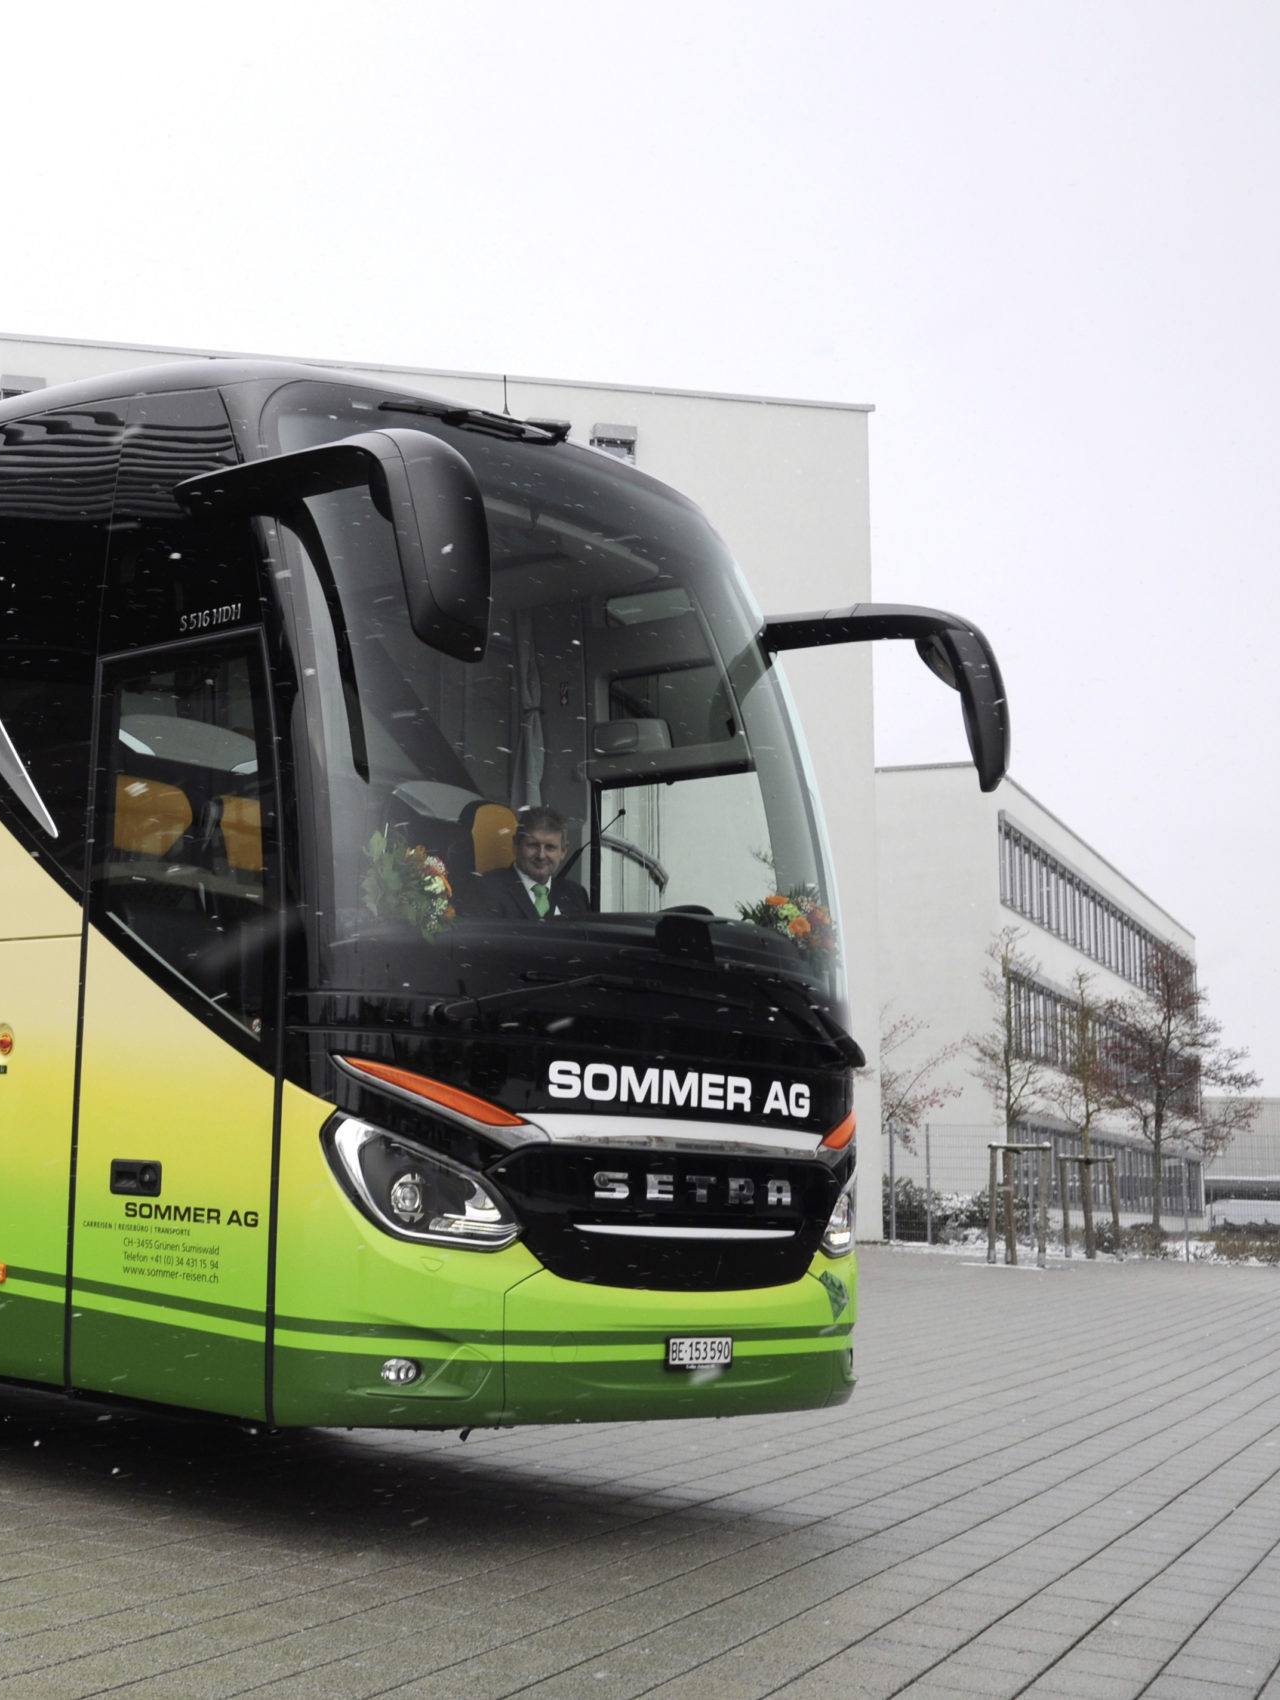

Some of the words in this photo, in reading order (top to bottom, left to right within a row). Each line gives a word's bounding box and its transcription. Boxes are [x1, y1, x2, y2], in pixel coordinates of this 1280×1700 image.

[179, 615, 188, 632] S
[189, 610, 210, 629] 516
[212, 603, 242, 625] HDH
[548, 1060, 752, 1113] SOMMER
[762, 1080, 811, 1119] AG
[593, 1171, 792, 1207] SETRA
[124, 1202, 221, 1225] SOMMER
[226, 1210, 259, 1228] AG
[82, 1220, 113, 1230] CARREISEN
[118, 1223, 149, 1233] REISEBÜRO
[154, 1226, 191, 1237] TRANSPORTE
[123, 1237, 153, 1249] CH-3455
[154, 1239, 180, 1252] Grünen
[181, 1242, 220, 1256] Sumiswald
[123, 1251, 149, 1263] Telefon
[150, 1254, 162, 1264] +41
[163, 1255, 174, 1266] (0)
[175, 1256, 184, 1266] 34
[185, 1258, 198, 1268] 431
[199, 1259, 208, 1269] 15
[209, 1260, 219, 1270] 94
[122, 1265, 219, 1284] www.sommer-reisen.ch
